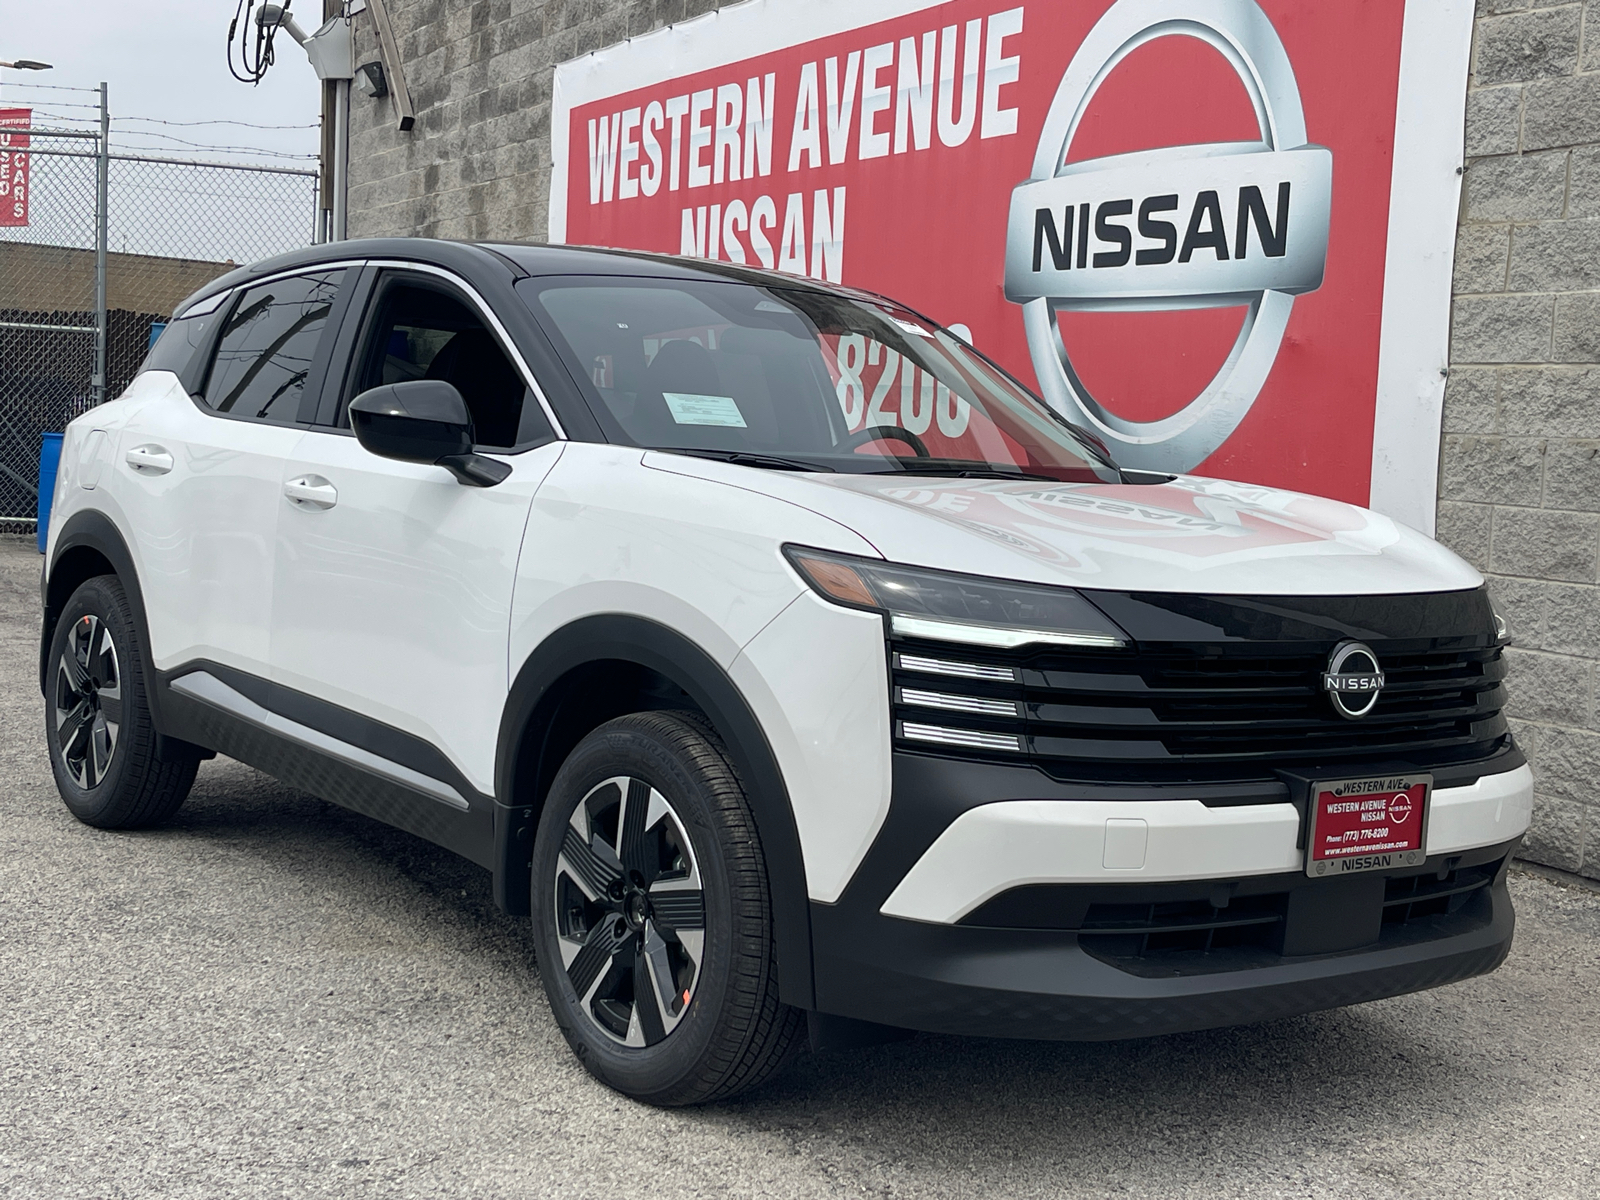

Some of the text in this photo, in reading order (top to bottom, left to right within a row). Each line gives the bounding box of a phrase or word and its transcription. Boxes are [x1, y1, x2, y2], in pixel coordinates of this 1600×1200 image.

[588, 6, 1024, 205] WESTERN AVENUE
[13, 152, 25, 218] CARS
[1032, 181, 1291, 273] NISSAN
[680, 186, 847, 285] NISSAN
[1327, 676, 1384, 690] NISSAN
[1342, 778, 1404, 794] WESTERN AVE
[1327, 799, 1386, 814] WESTERN AVENUE
[1361, 811, 1385, 822] NISSAN
[1326, 827, 1389, 843] Phone: (773) 776-8200
[1341, 855, 1391, 871] NISSAN
